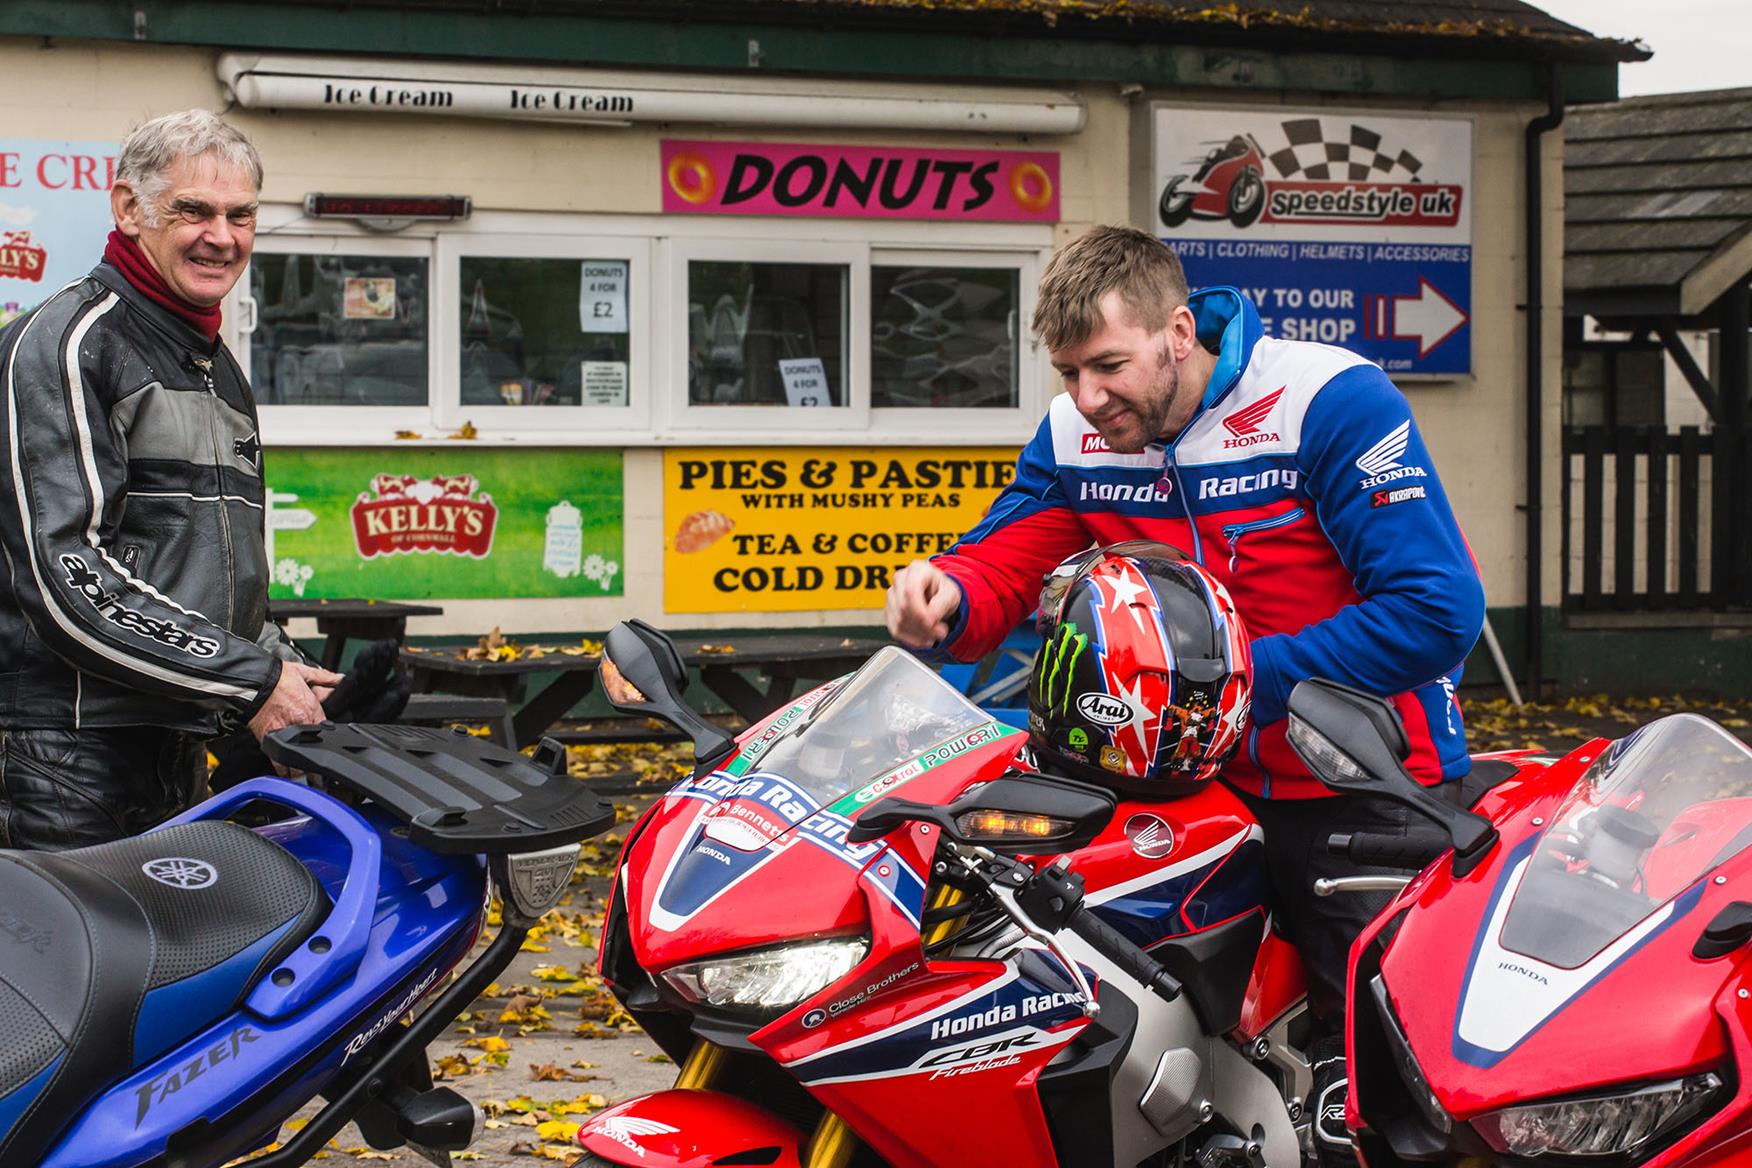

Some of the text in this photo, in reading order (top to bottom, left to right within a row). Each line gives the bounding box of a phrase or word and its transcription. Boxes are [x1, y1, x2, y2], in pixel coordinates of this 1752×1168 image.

[324, 84, 453, 107] Ice Cream
[510, 89, 634, 112] Ice Cream
[720, 154, 1000, 212] DONUTS
[1270, 189, 1454, 219] speedstyle uk
[1217, 242, 1290, 258] CLOTHING
[1300, 243, 1365, 260] HELMETS
[1373, 245, 1470, 262] ACCESSORIES
[584, 267, 623, 278] DONUTS
[589, 282, 617, 292] 4 FOR
[1273, 290, 1303, 308] TO
[1309, 289, 1354, 308] OUR
[593, 302, 614, 318] £2
[1282, 318, 1356, 343] SHOP
[1223, 433, 1281, 449] HONDA
[678, 459, 1016, 490] PIES & PASTIE
[1198, 468, 1298, 500] Racing
[1360, 467, 1428, 490] HONDA
[741, 493, 961, 509] WITH MUSHY PEAS
[364, 504, 484, 537] KELLY'S
[732, 533, 962, 555] TEA & COFFE
[713, 566, 824, 592] COLD
[1081, 697, 1127, 718] Arai
[731, 805, 790, 843] Bennetts
[696, 845, 731, 866] HONDA
[1138, 839, 1171, 851] HONDA
[1498, 962, 1548, 985] HONDA
[828, 992, 864, 1014] Close
[866, 961, 920, 995] Brothers
[930, 1004, 1017, 1040] Honda
[918, 1031, 1043, 1069] CBR
[135, 1026, 261, 1131] FAZER
[928, 1054, 1022, 1081] Fireblade
[591, 1126, 646, 1158] HONDA
